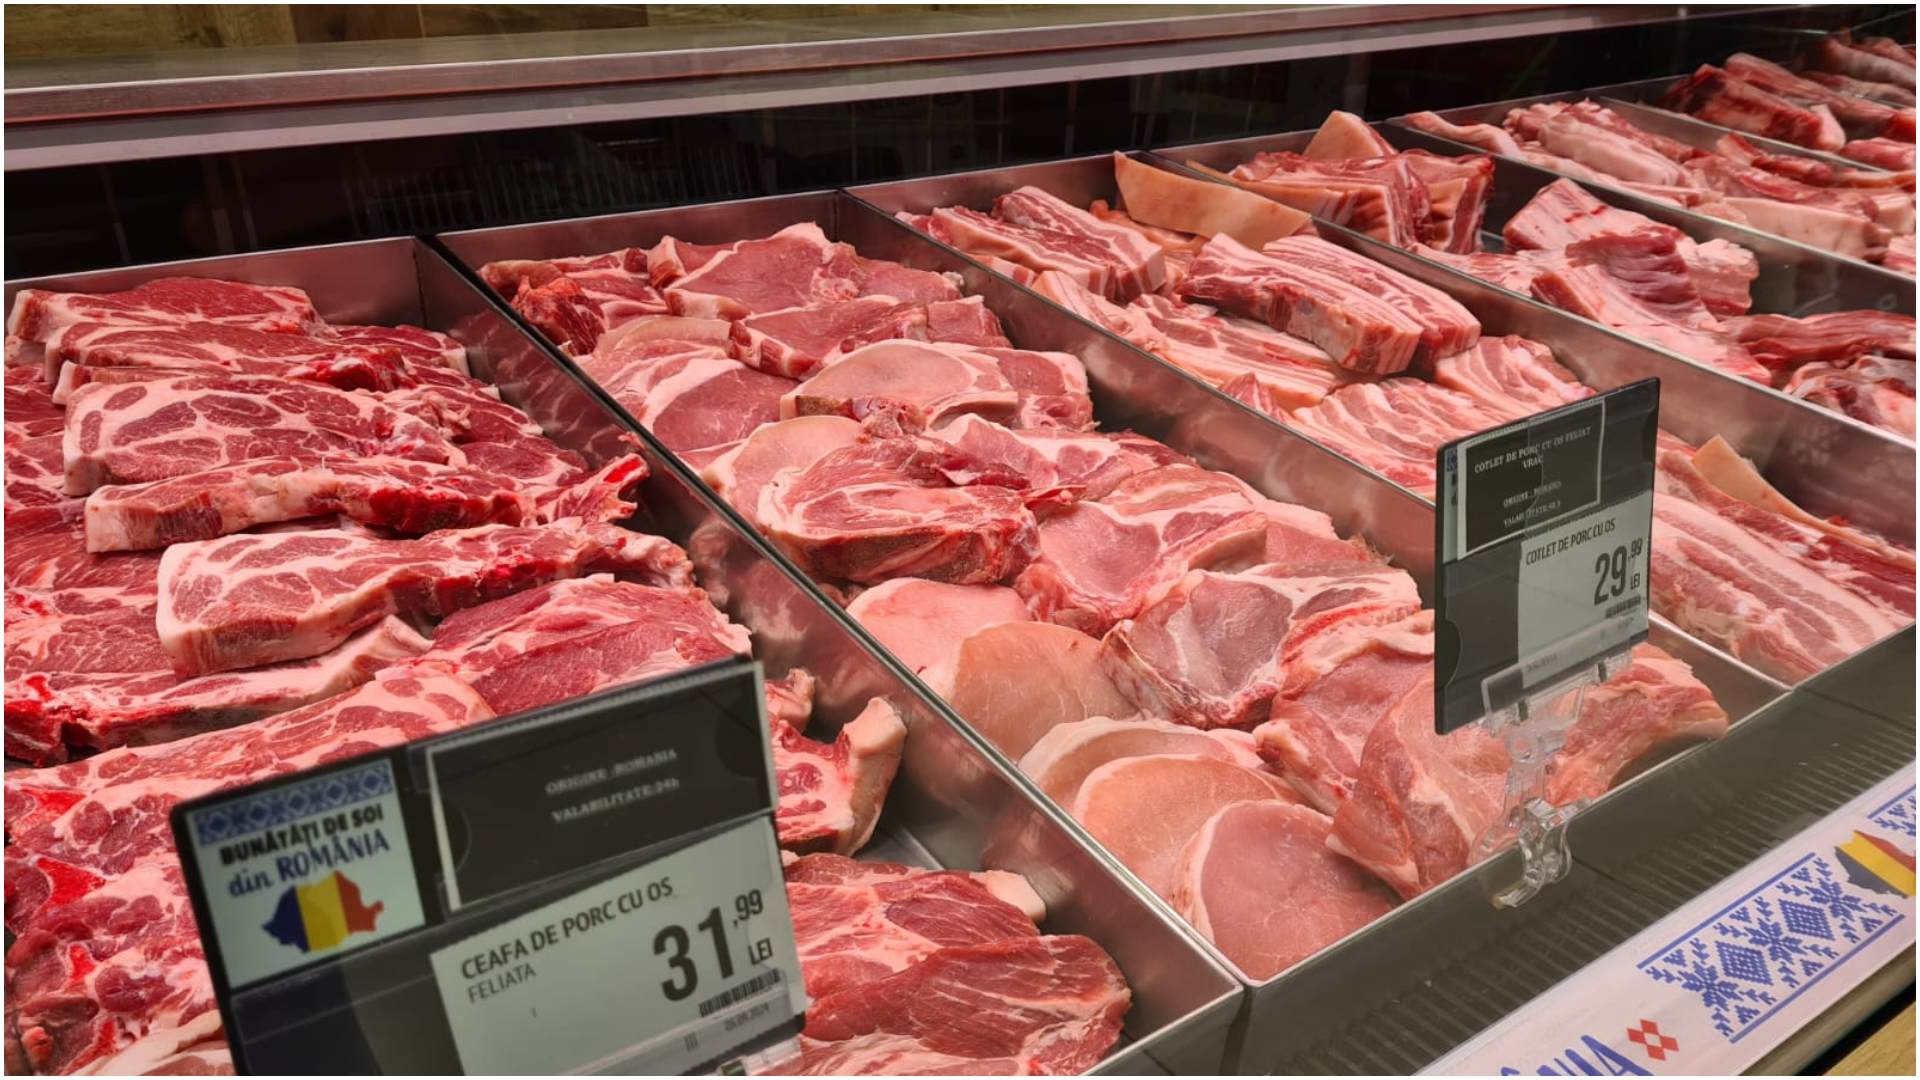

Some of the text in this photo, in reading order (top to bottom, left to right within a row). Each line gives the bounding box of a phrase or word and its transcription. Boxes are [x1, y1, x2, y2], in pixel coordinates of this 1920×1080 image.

[1474, 455, 1504, 474] COTLET
[1506, 450, 1518, 463] DE
[1525, 518, 1616, 565] COTLET DE PORC CU OS
[1630, 573, 1640, 590] LEI
[323, 814, 350, 837] DE
[352, 804, 384, 829] SOI
[228, 828, 390, 897] din ROMÂNIA
[460, 876, 674, 980] CEAFA DE PORC CU OS
[748, 936, 774, 967] LEI
[466, 962, 538, 1005] FELIATA
